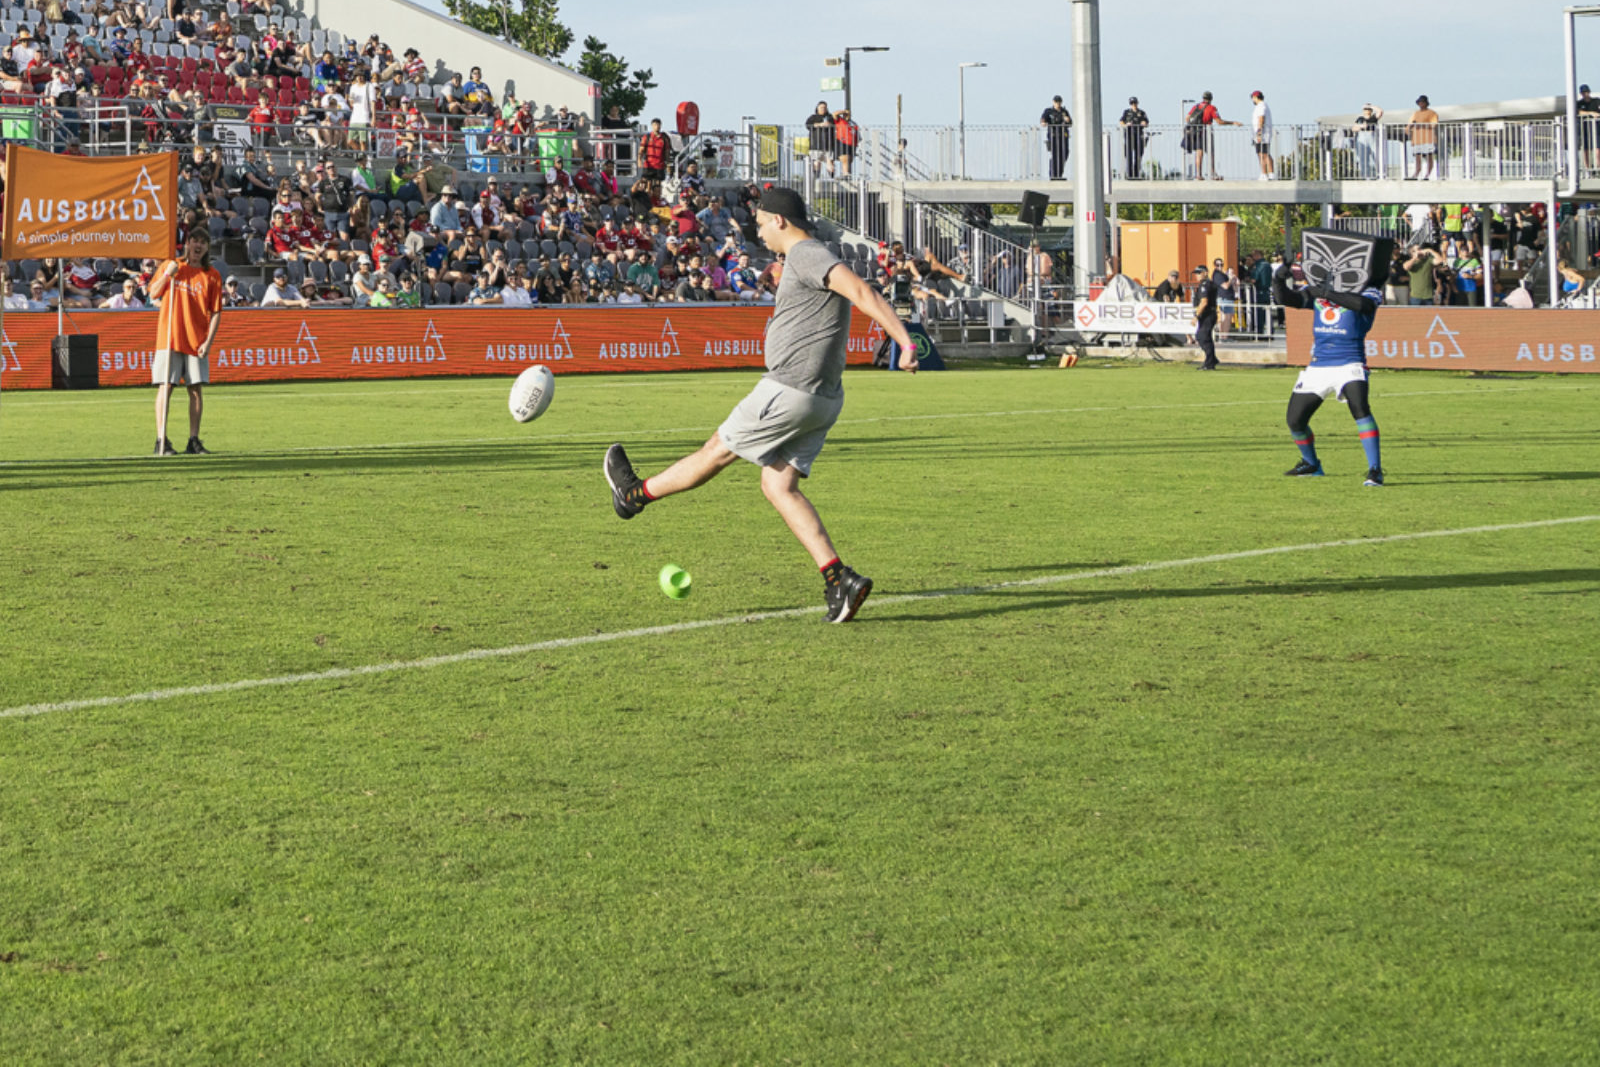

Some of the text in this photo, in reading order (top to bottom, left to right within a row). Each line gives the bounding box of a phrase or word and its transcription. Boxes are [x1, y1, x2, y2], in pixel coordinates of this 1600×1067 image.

[17, 198, 148, 223] AUSBUILD
[16, 229, 150, 245] A simple journey home
[1099, 305, 1135, 319] IRB
[351, 346, 435, 363] AUSBUILD
[485, 344, 563, 361] AUSBUILD
[599, 342, 671, 359] AUSBUILD
[704, 340, 765, 356] AUSBUIL
[1366, 340, 1444, 358] BUILD
[218, 348, 309, 366] AUSBUILD
